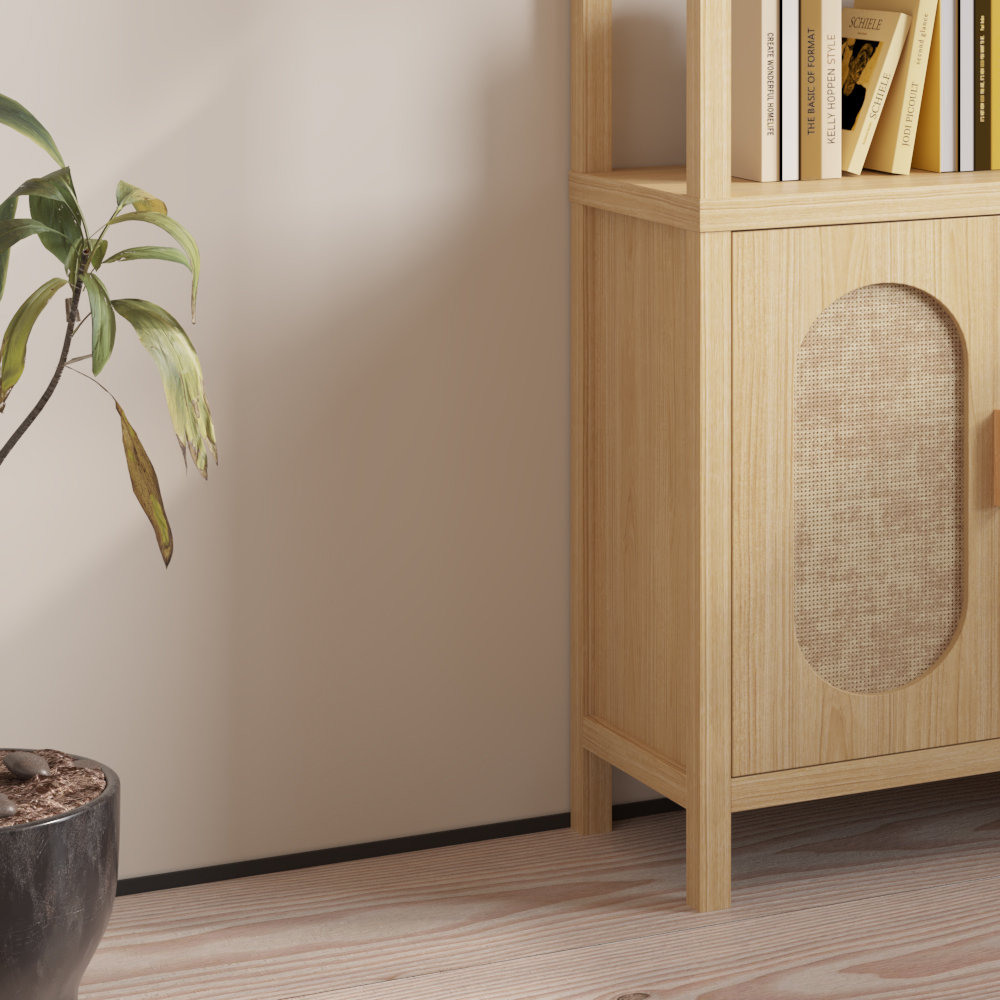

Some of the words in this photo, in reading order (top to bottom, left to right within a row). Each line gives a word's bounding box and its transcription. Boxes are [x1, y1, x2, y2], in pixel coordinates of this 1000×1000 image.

[849, 16, 883, 31] SCHIELE
[807, 28, 815, 68] FORMAT
[827, 34, 835, 65] STYLE
[807, 71, 815, 84] OF
[827, 68, 835, 110] HOPPEN
[807, 87, 815, 114] BASIC
[870, 72, 892, 120] SCHIELE
[807, 117, 815, 136] THE
[827, 114, 835, 144] KELLY
[902, 125, 913, 147] JODI
